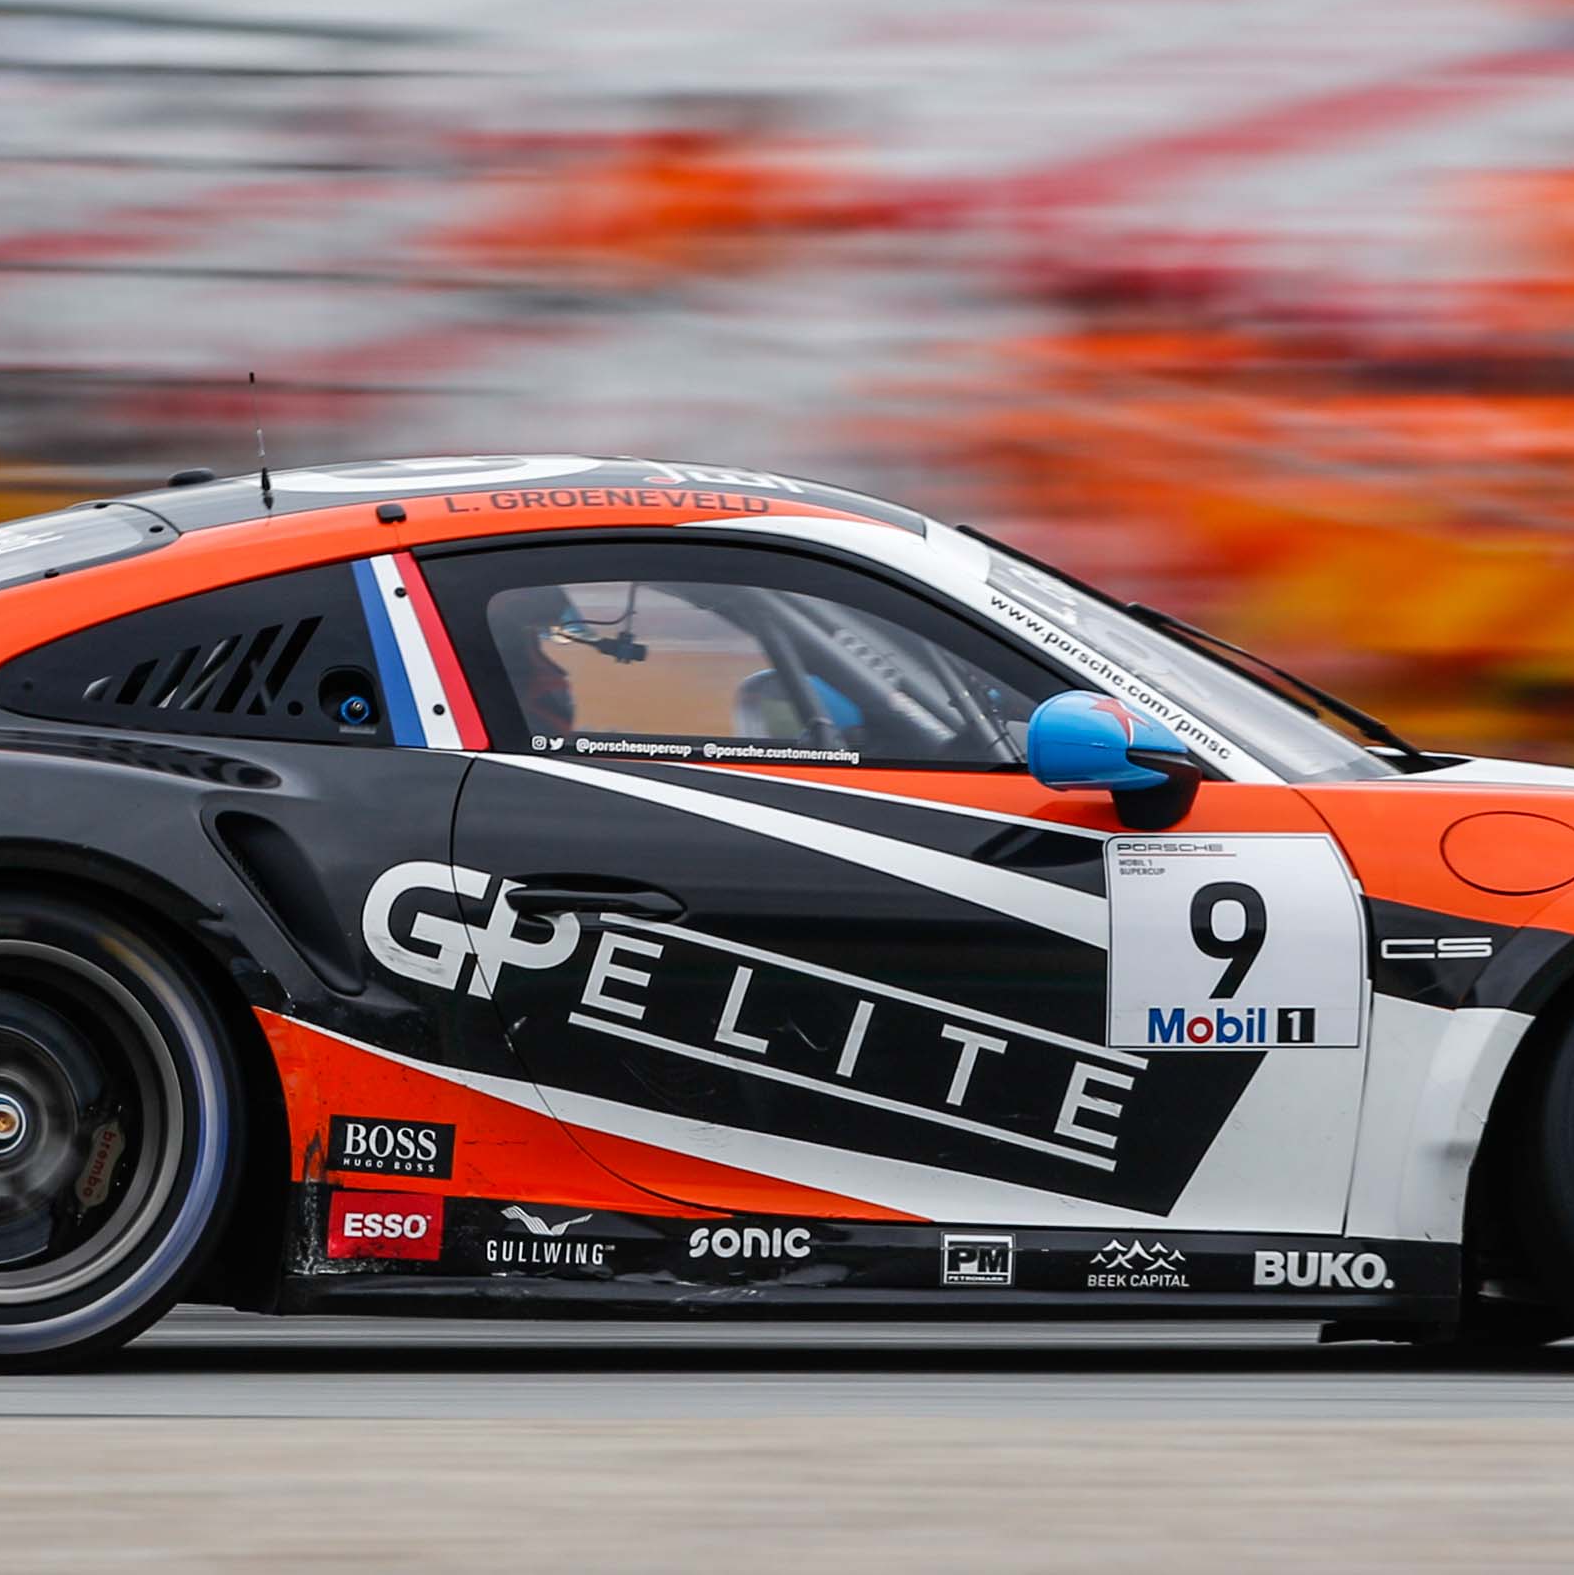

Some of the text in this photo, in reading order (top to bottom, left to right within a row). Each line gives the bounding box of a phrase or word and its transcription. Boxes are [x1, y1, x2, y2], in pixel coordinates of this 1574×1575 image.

[446, 489, 770, 514] L. GROENEVELD
[990, 593, 1233, 761] www.porsche.com/pmsc
[575, 737, 861, 765] @porschesupercup @porsche.customerracing
[1116, 843, 1223, 852] PORSCHE
[1190, 881, 1268, 999] 9
[1381, 937, 1492, 959] CS
[362, 861, 1136, 1151] GP ELITE
[1148, 1007, 1267, 1044] Mobil
[343, 1123, 437, 1161] BOSS
[83, 1130, 117, 1198] brembo
[343, 1158, 434, 1173] HUGO BOSS
[343, 1212, 428, 1239] ESSO
[486, 1239, 604, 1266] GULLWING
[948, 1247, 1008, 1273] PM
[1087, 1273, 1190, 1288] BEEK CAPITAL
[1253, 1250, 1396, 1290] BUKO.
